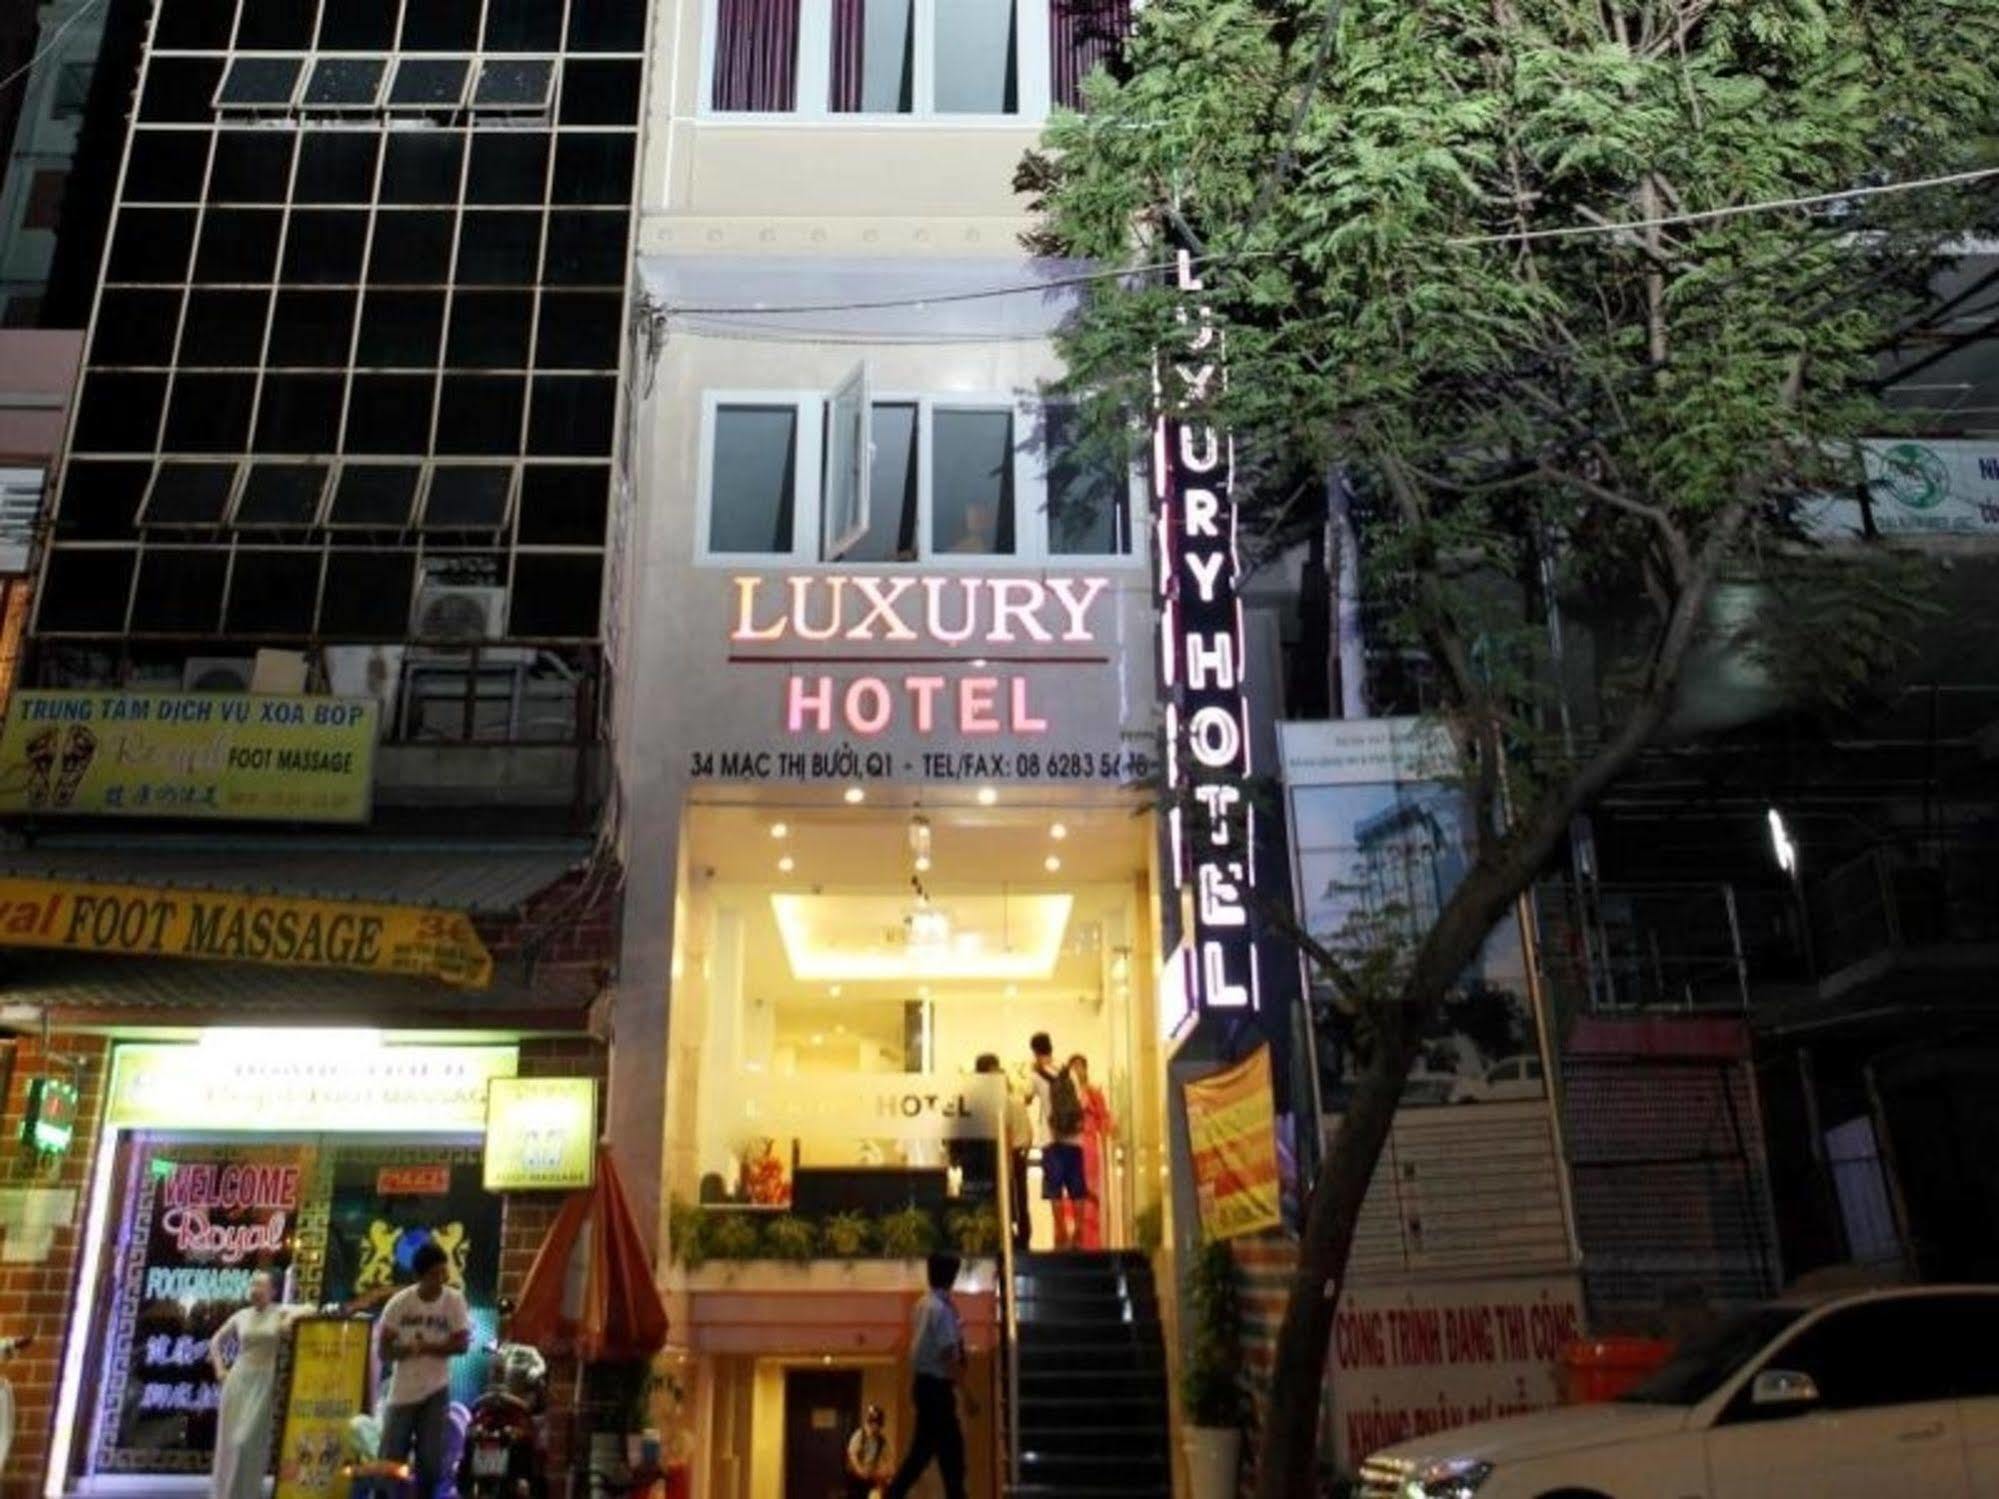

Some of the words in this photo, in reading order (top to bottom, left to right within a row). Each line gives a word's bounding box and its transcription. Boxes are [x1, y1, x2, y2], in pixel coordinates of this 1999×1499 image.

[731, 576, 1109, 642] LUXURY
[19, 698, 92, 721] TRUNG
[787, 675, 1048, 732] HOTEL
[228, 747, 270, 770] FOOT
[276, 749, 354, 775] MASSAGE
[690, 752, 713, 778] 34
[923, 752, 1010, 779] TEL/FAX:
[1017, 752, 1041, 778] 08
[1047, 752, 1095, 778] 6283
[1186, 631, 1249, 1007] HOTEL
[63, 894, 179, 950] FOOT
[182, 900, 384, 963] MASSAGE
[164, 1164, 299, 1208] WELCOME
[163, 1205, 286, 1263] Royal
